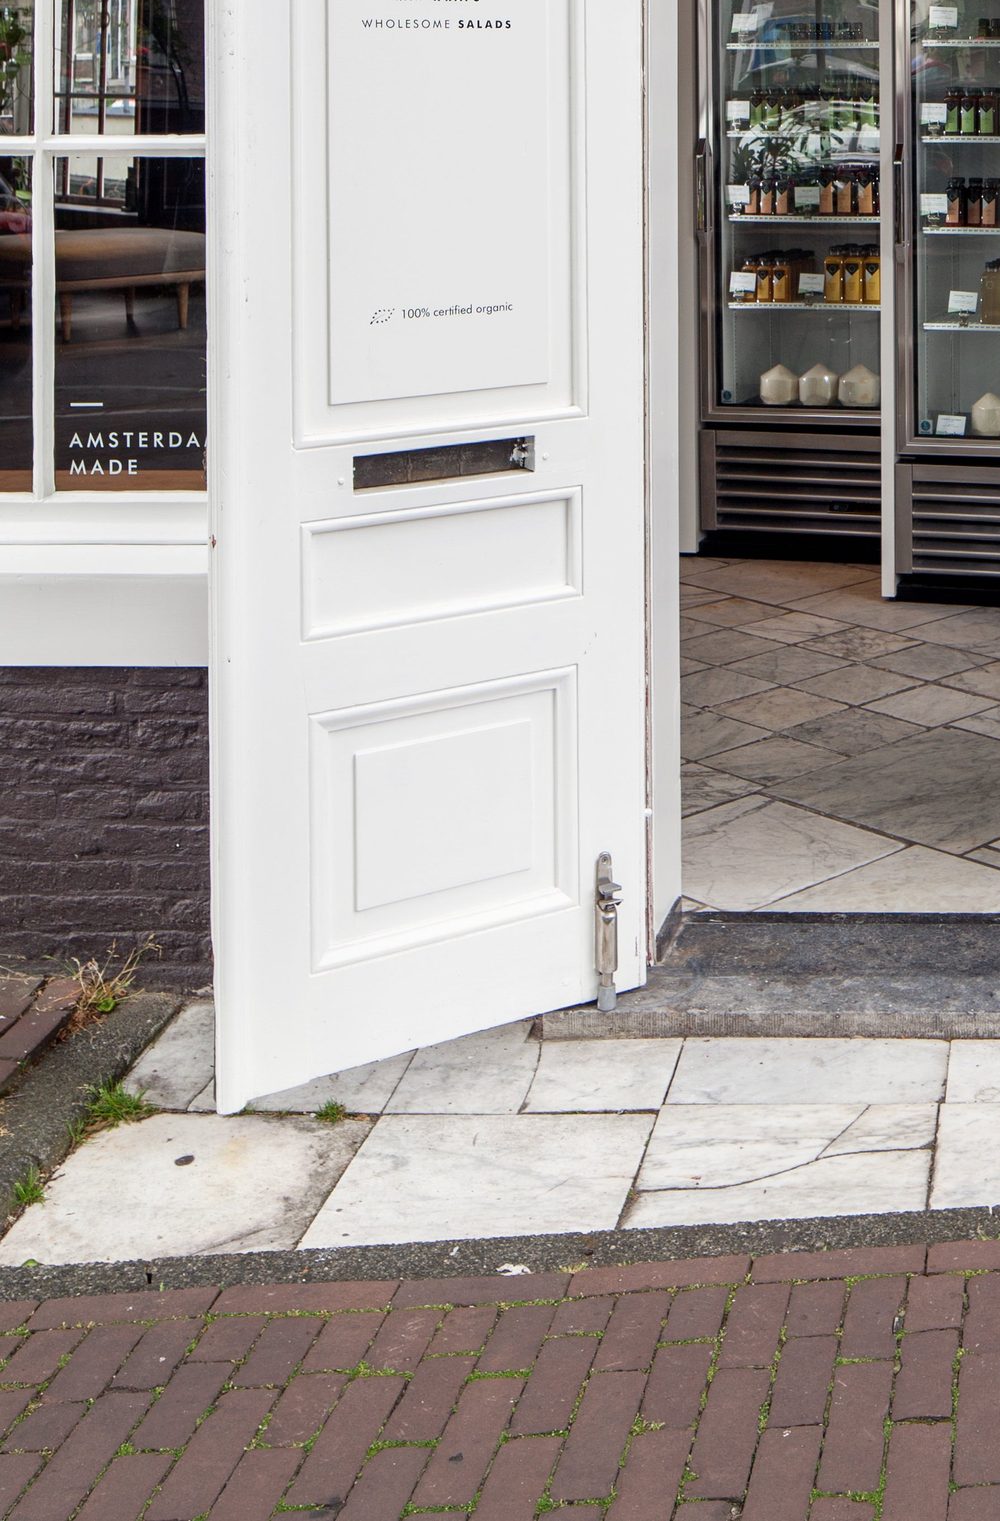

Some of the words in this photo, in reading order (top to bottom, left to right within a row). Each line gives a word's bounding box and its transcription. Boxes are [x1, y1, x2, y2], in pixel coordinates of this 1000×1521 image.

[361, 19, 450, 30] WHOLESOME
[457, 19, 512, 30] SALADS
[401, 307, 431, 319] 100%
[433, 304, 473, 317] certified
[475, 301, 513, 316] organic
[68, 431, 207, 449] AMSTERDA
[68, 459, 139, 476] MADE
